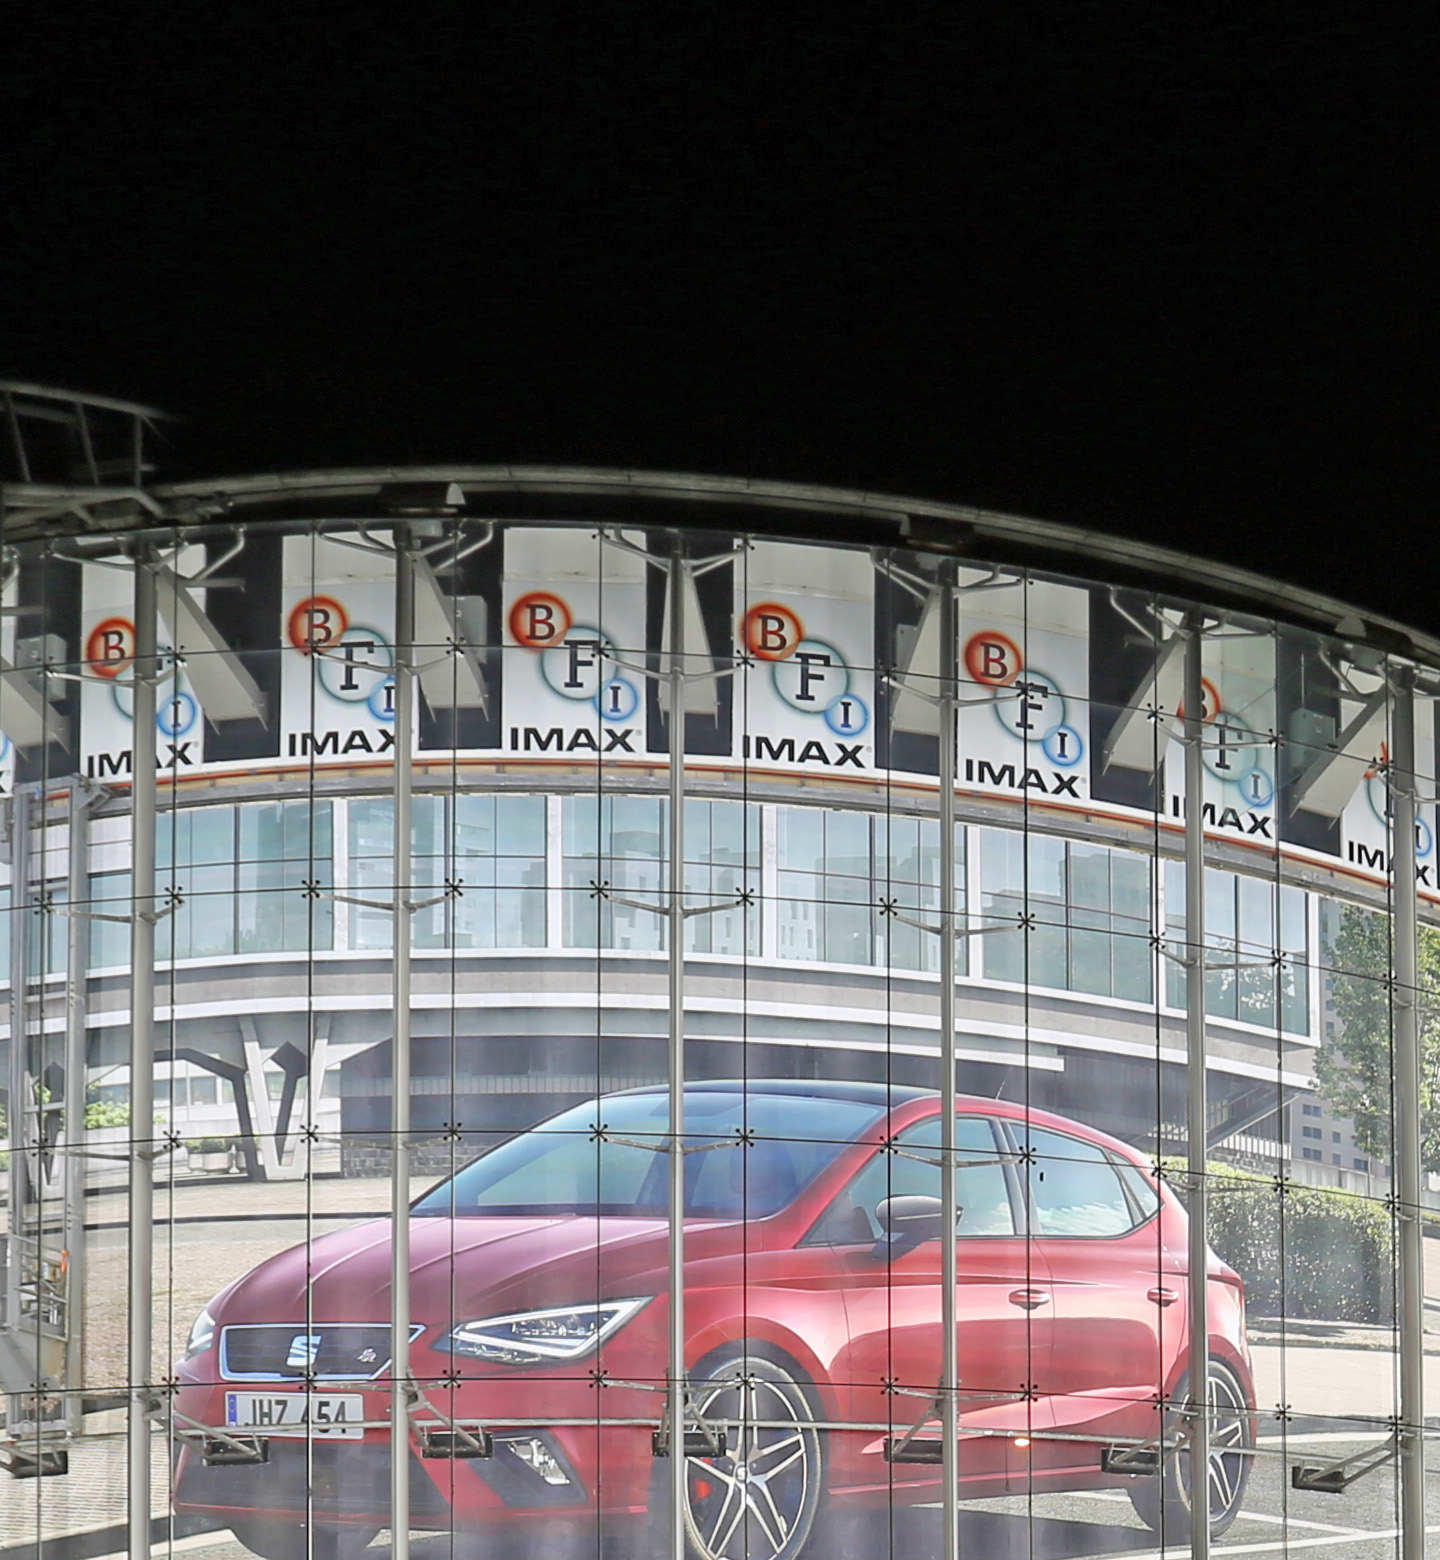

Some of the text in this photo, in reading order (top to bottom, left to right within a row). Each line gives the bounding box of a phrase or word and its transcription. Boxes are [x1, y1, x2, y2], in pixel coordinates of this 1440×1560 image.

[509, 726, 636, 753] IMAX
[743, 734, 867, 768] IMAX
[88, 742, 192, 778] IMX
[965, 758, 1082, 799] IMAX
[1348, 841, 1431, 888] IMX
